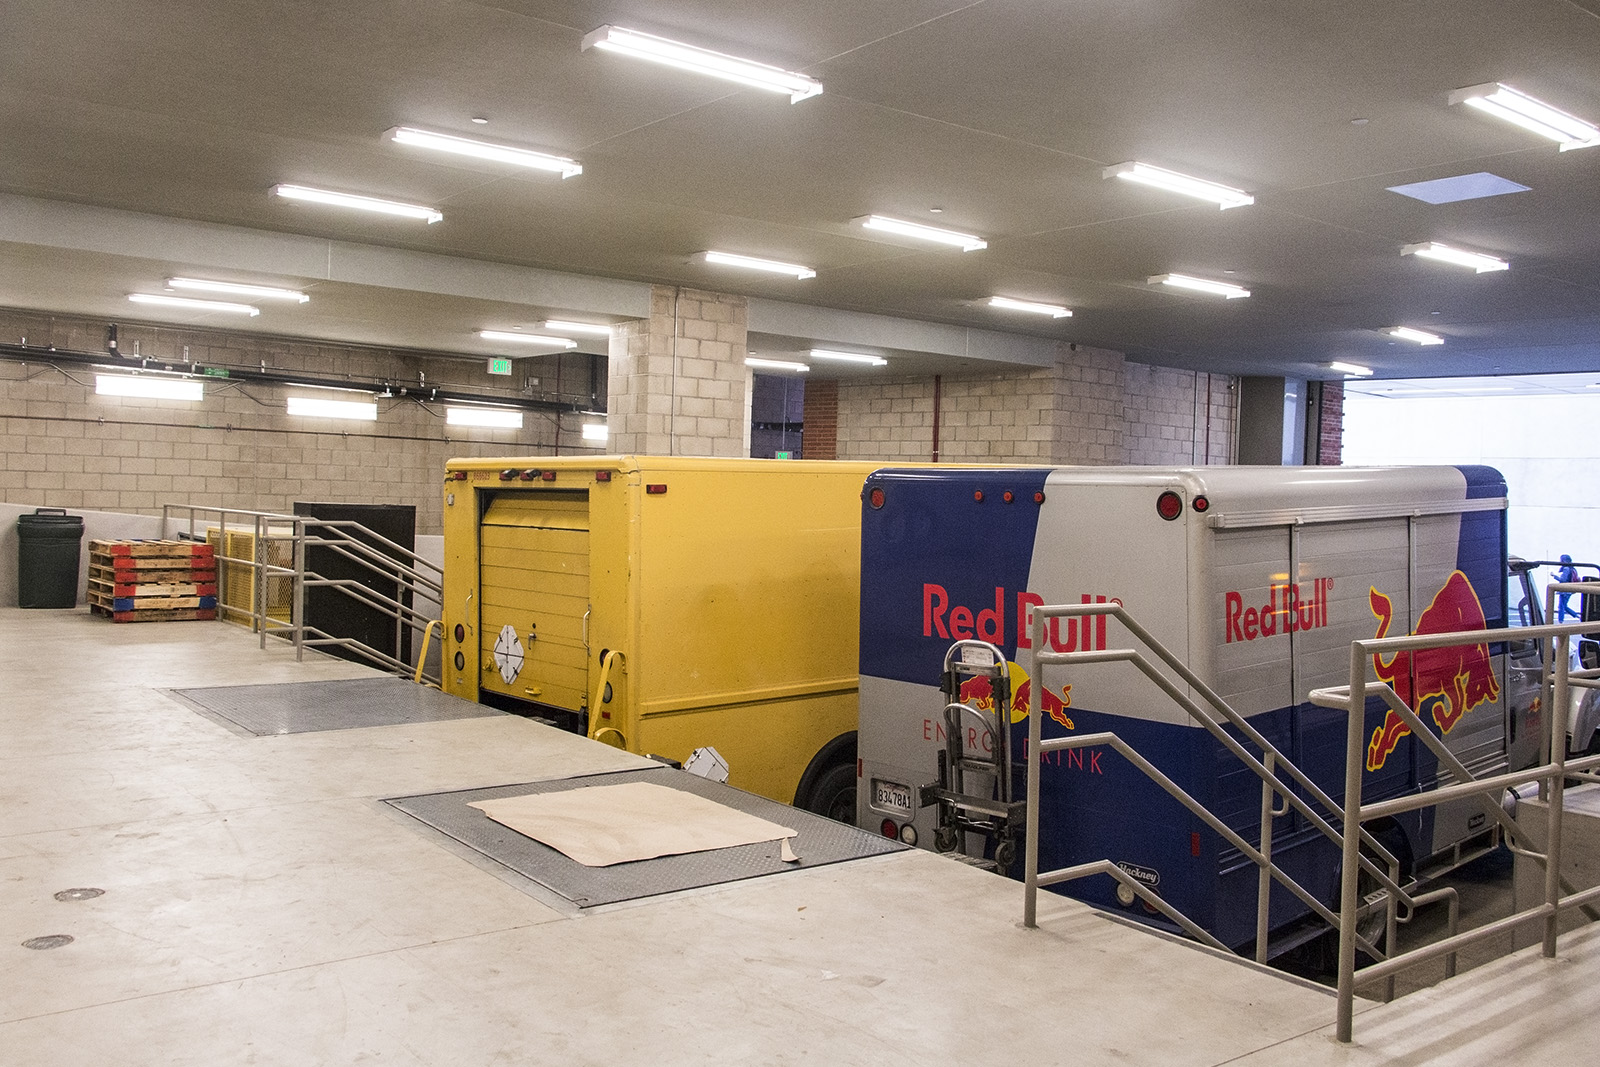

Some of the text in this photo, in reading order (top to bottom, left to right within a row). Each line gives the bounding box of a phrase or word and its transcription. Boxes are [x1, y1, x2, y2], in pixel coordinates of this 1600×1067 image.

[493, 360, 508, 373] EXIT
[923, 583, 1005, 647] Red
[1226, 583, 1276, 643] Red
[923, 719, 1007, 754] ENRG
[878, 789, 911, 809] 83478A1
[1119, 863, 1157, 883] Hackney
